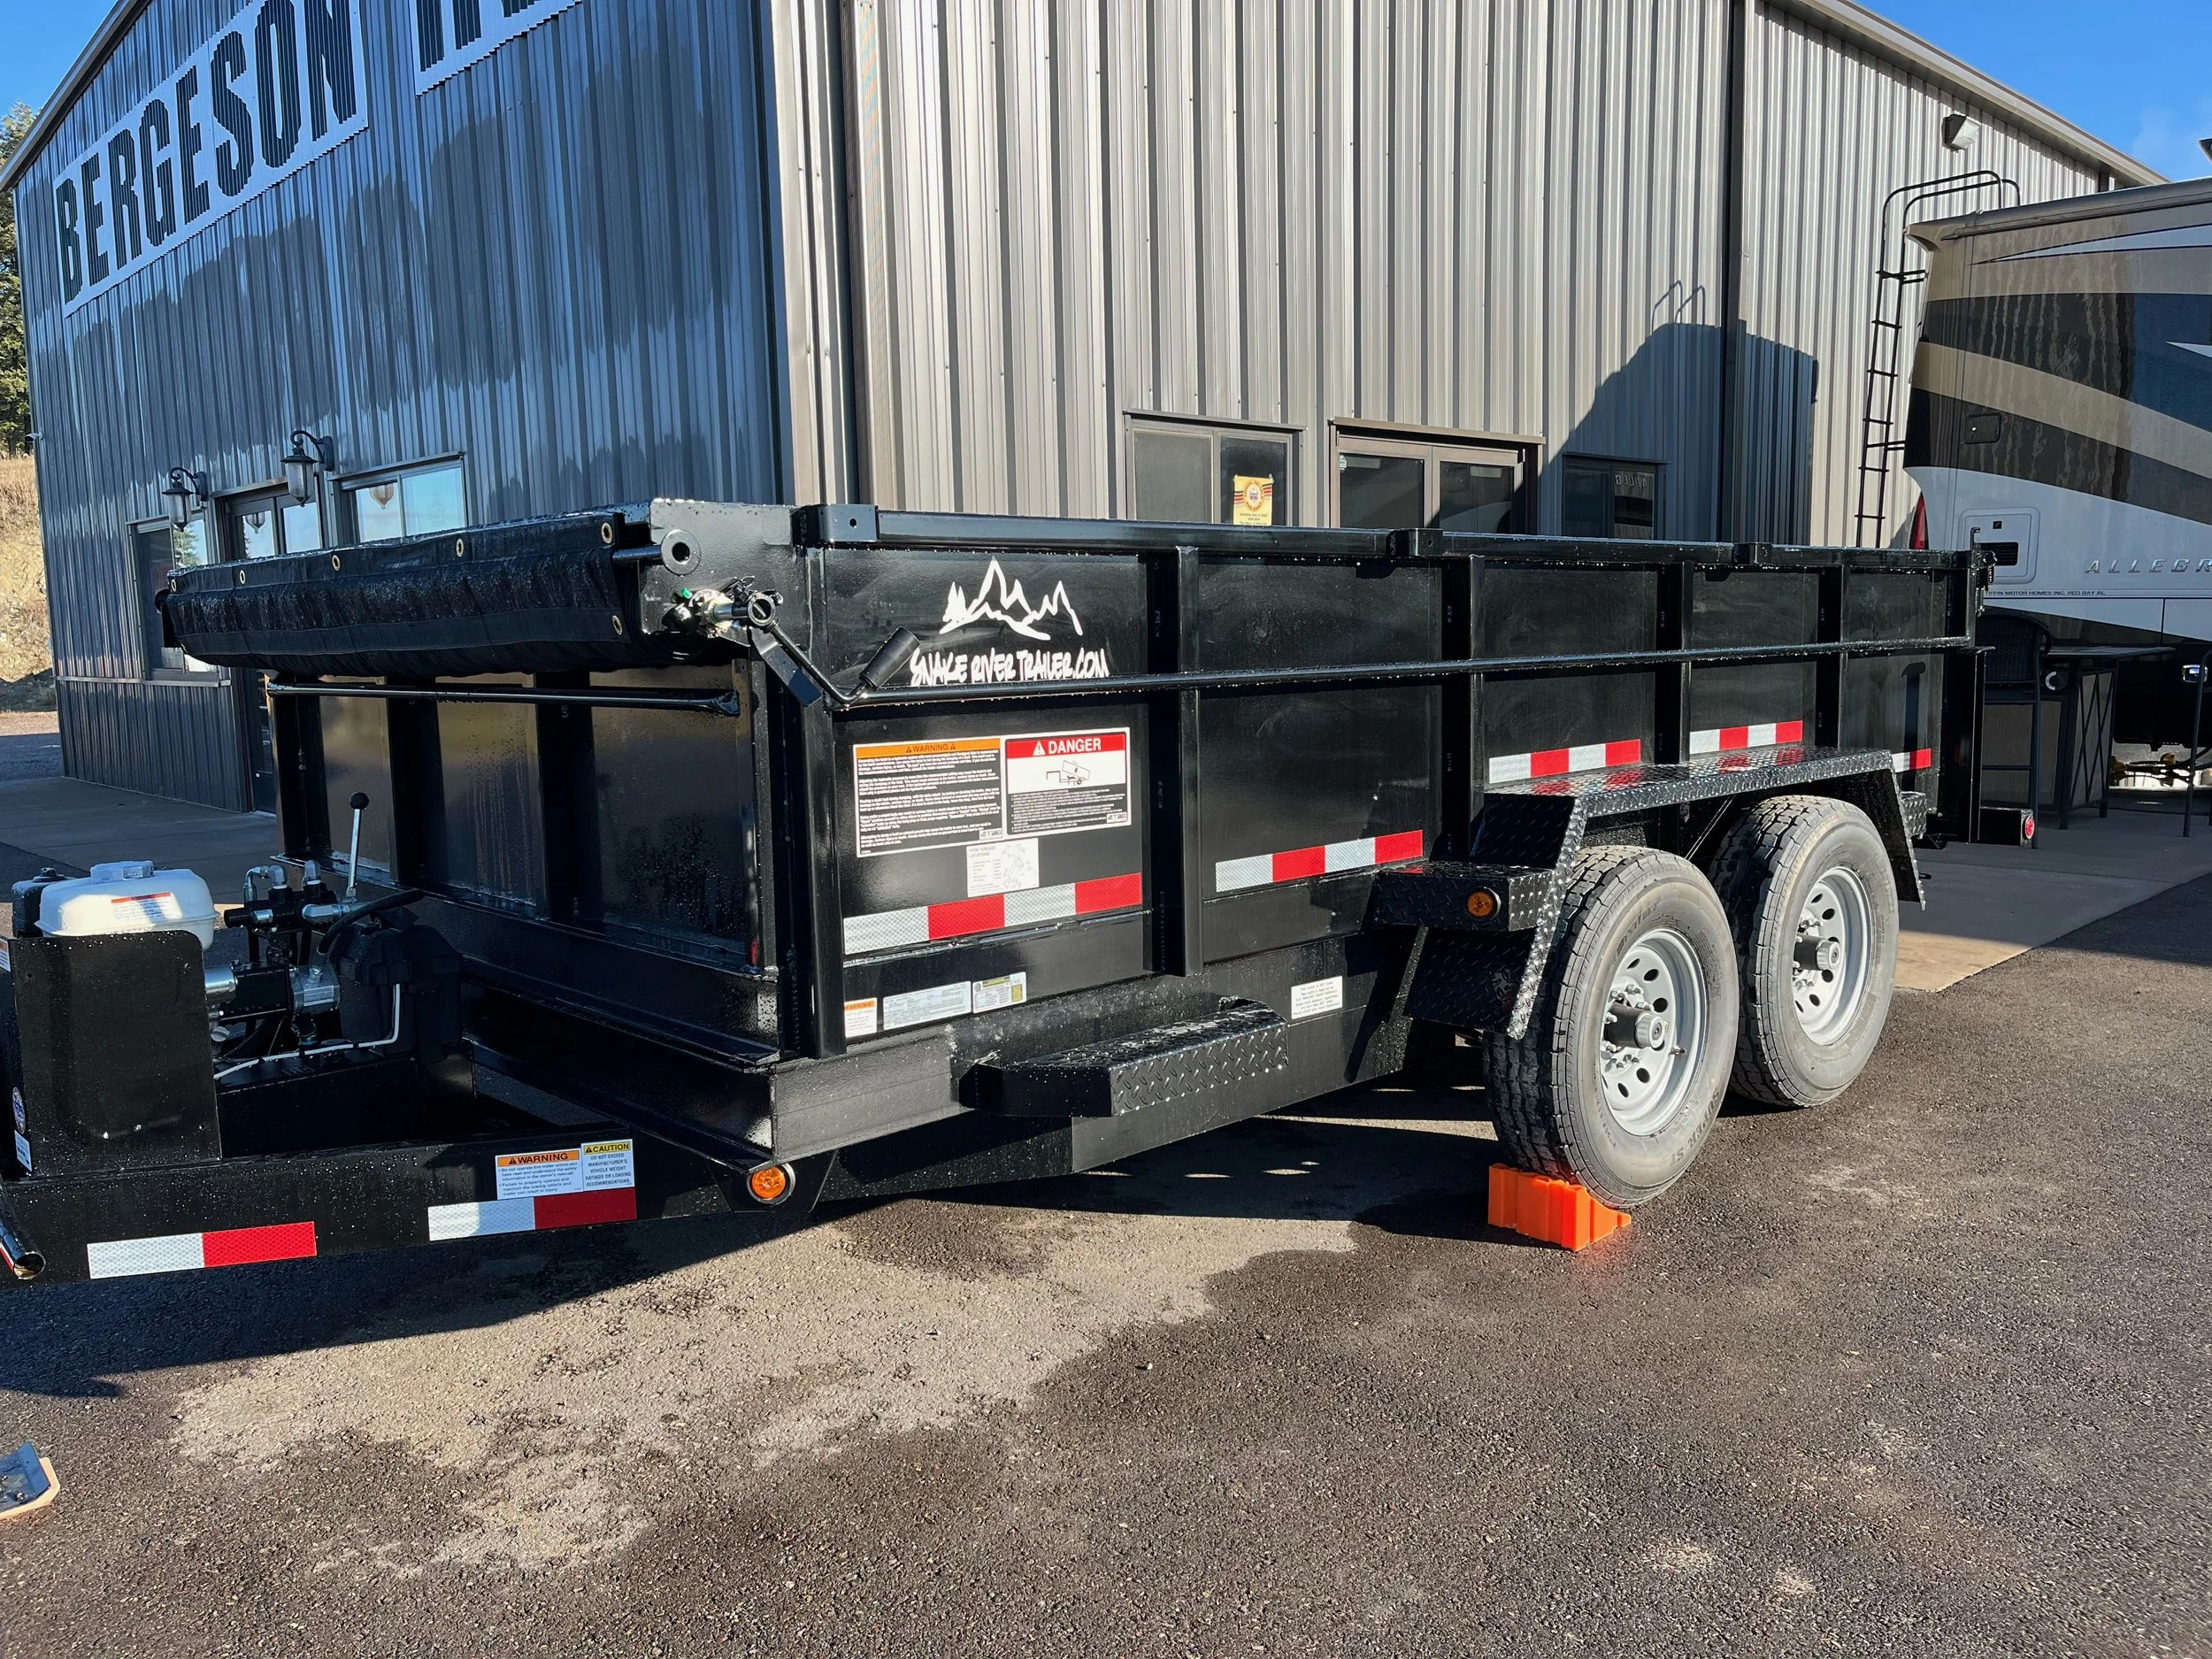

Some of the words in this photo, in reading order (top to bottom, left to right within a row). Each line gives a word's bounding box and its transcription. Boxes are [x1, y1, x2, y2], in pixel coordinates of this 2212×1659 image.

[56, 0, 357, 303] BERGESON
[2085, 558, 2212, 573] ALLEGR
[971, 647, 1016, 683] RIVER
[912, 743, 949, 752] WARNING
[1048, 738, 1101, 754] DANGER
[593, 1144, 629, 1152] CAUTION
[517, 1152, 567, 1163] WARNING
